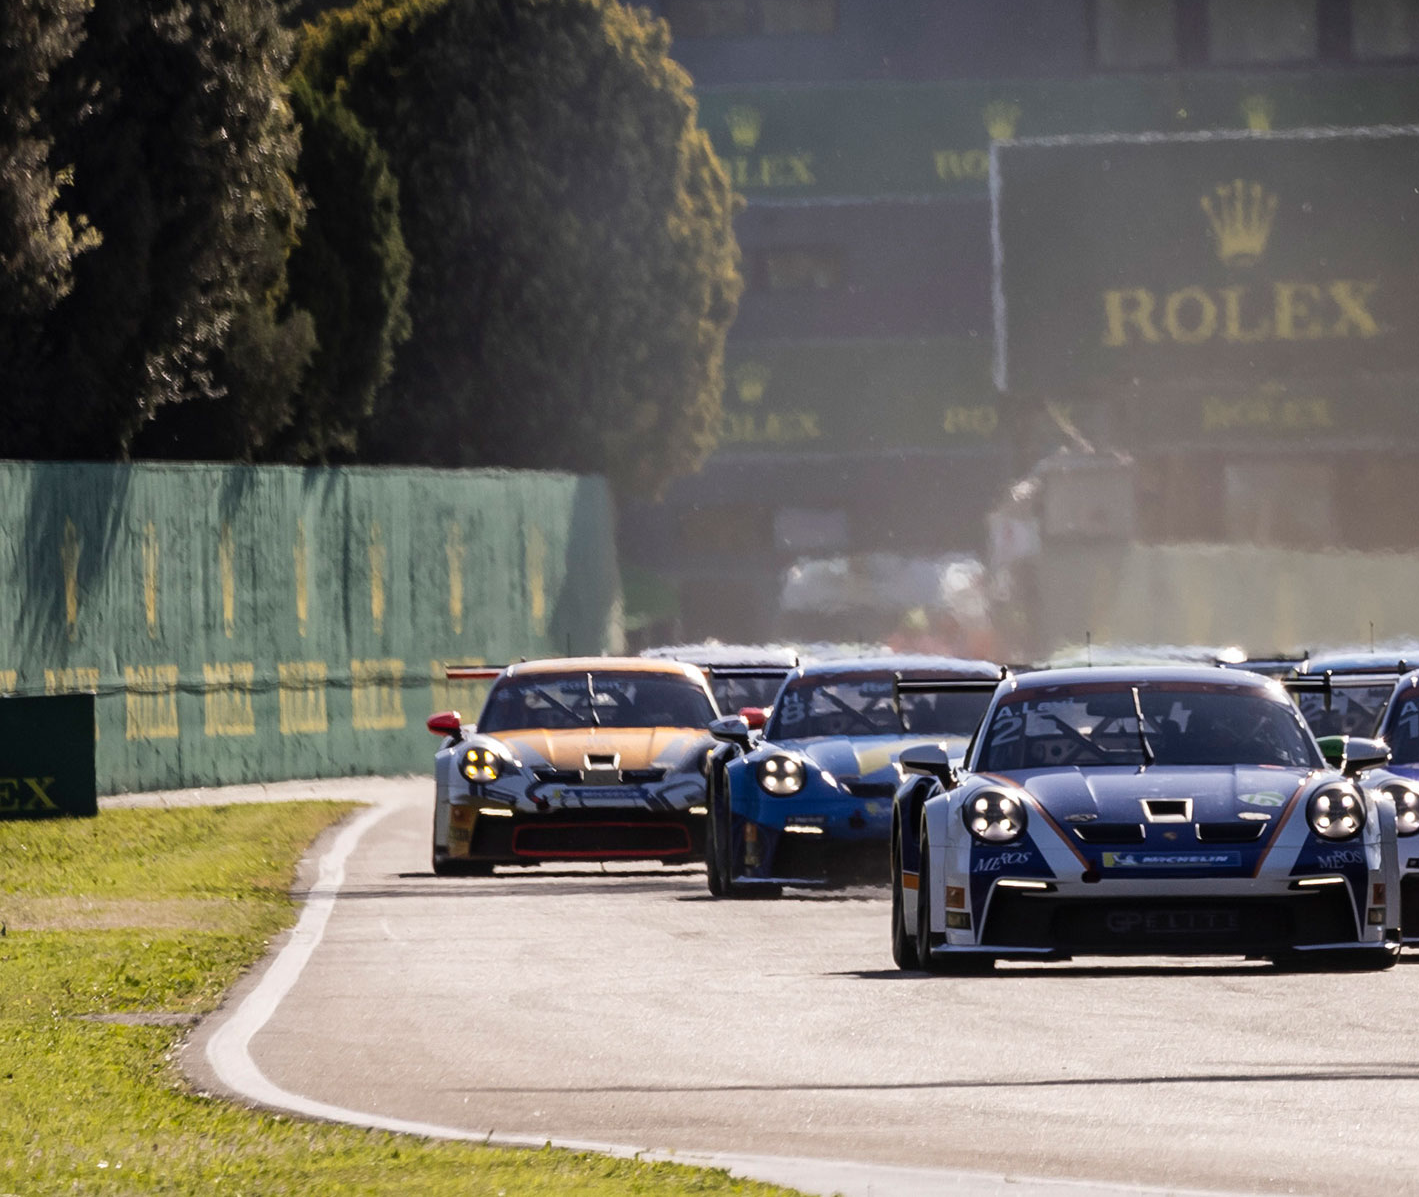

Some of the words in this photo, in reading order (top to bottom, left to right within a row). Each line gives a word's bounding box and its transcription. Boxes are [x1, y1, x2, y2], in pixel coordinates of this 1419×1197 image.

[1103, 277, 1382, 346] ROLEX
[973, 852, 1032, 873] MEROS
[1141, 854, 1228, 864] MICHELIN
[1317, 851, 1363, 869] MEROS
